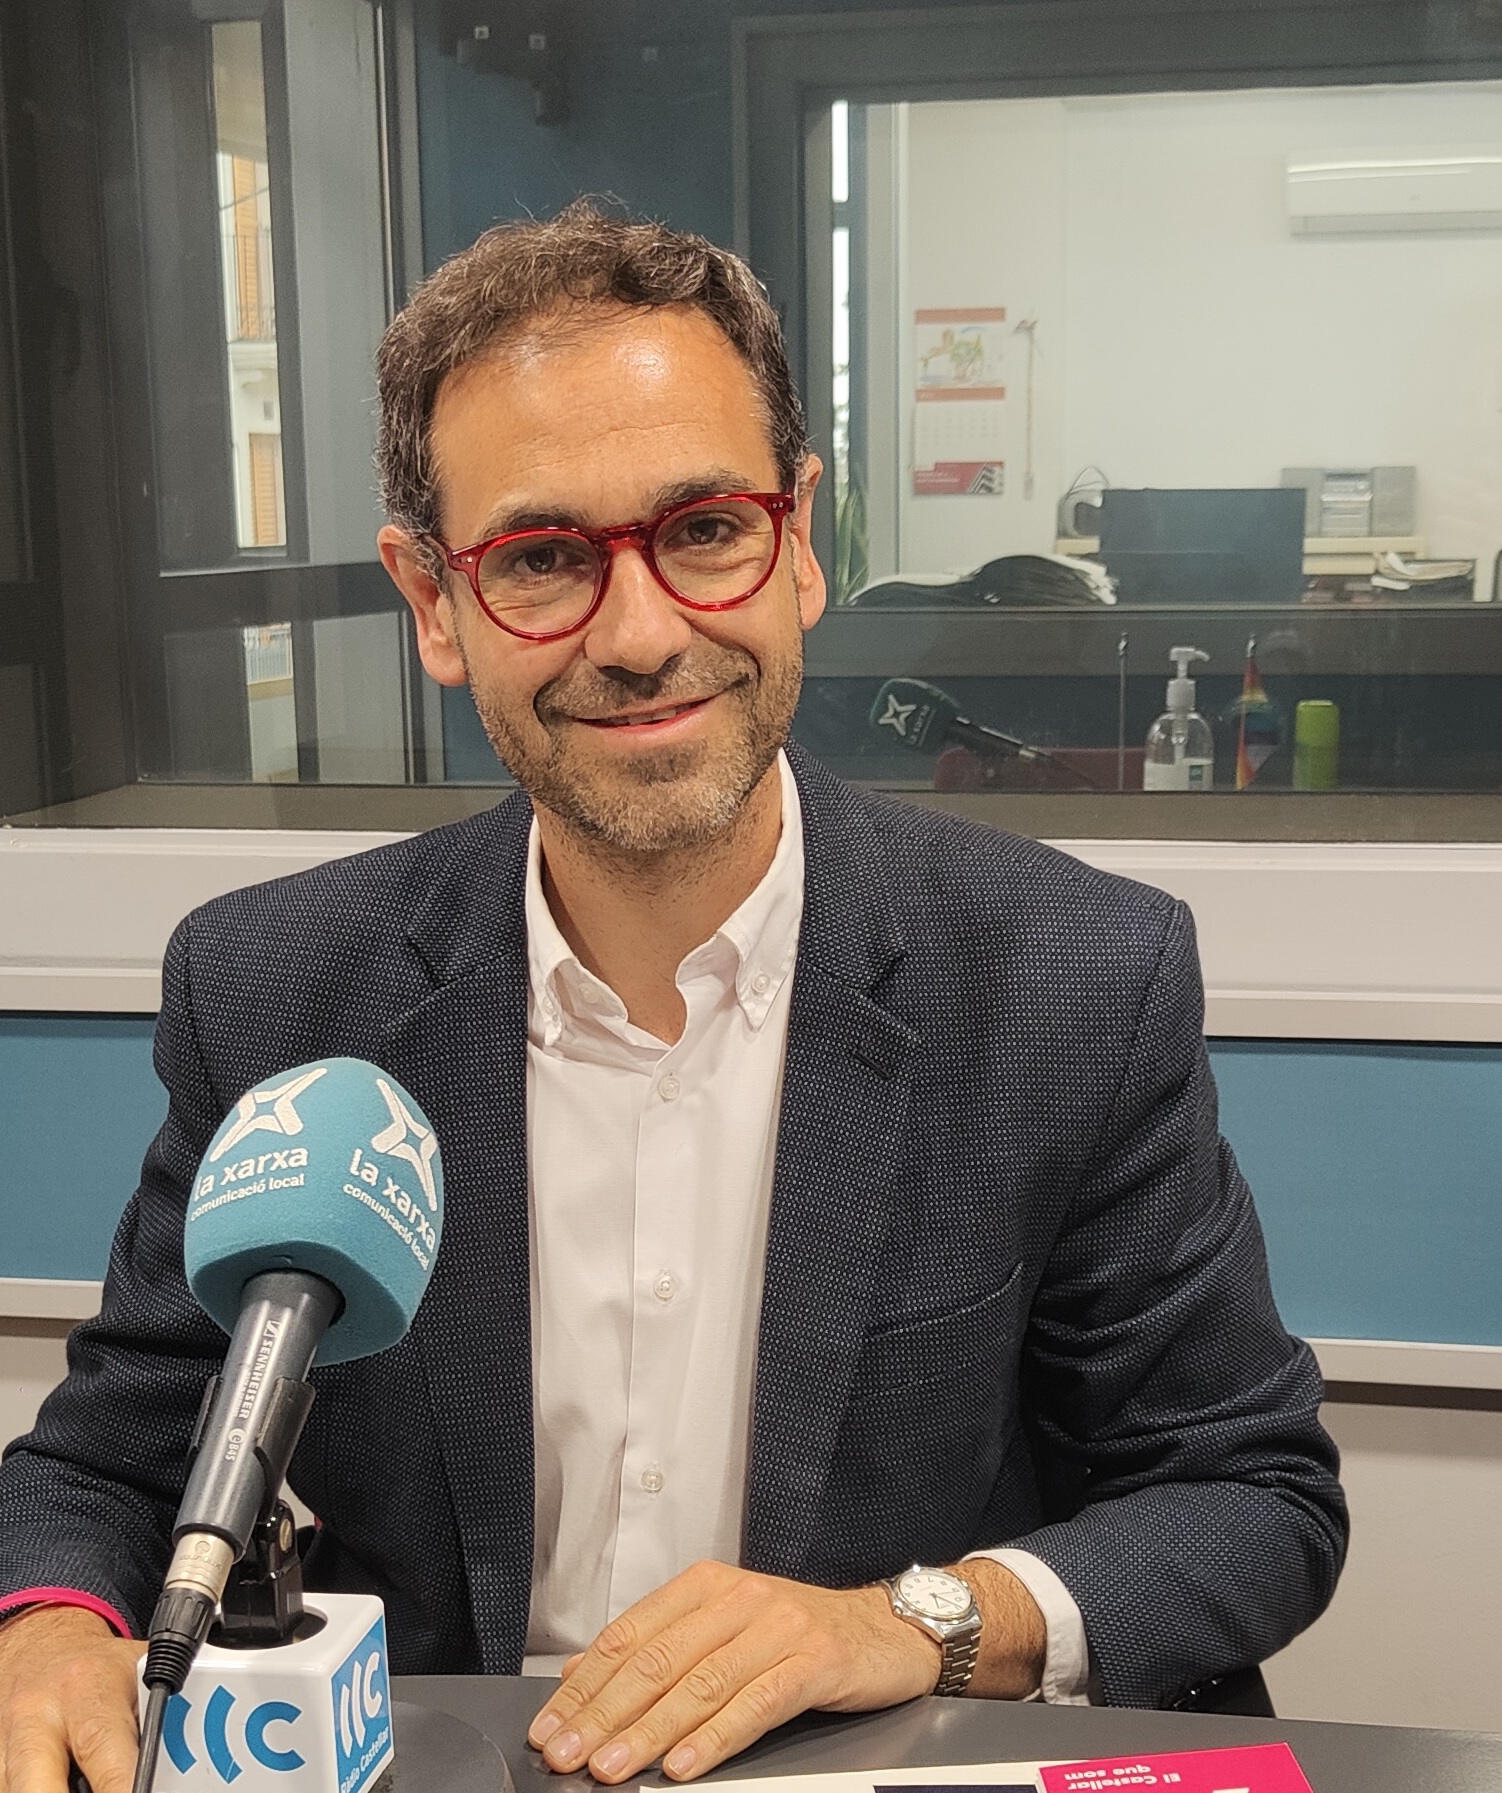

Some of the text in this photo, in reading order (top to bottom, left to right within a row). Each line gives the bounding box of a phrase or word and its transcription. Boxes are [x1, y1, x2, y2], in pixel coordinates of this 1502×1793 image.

[190, 1172, 305, 1222] comunicació local
[194, 1147, 309, 1202] la xarxa
[350, 1147, 436, 1253] la xarxa
[342, 1183, 430, 1271] comunicació local
[237, 1337, 275, 1419] SENNHEISER
[359, 1725, 389, 1773] Castellar
[1064, 1764, 1151, 1781] que som
[1067, 1772, 1181, 1791] El Castellar
